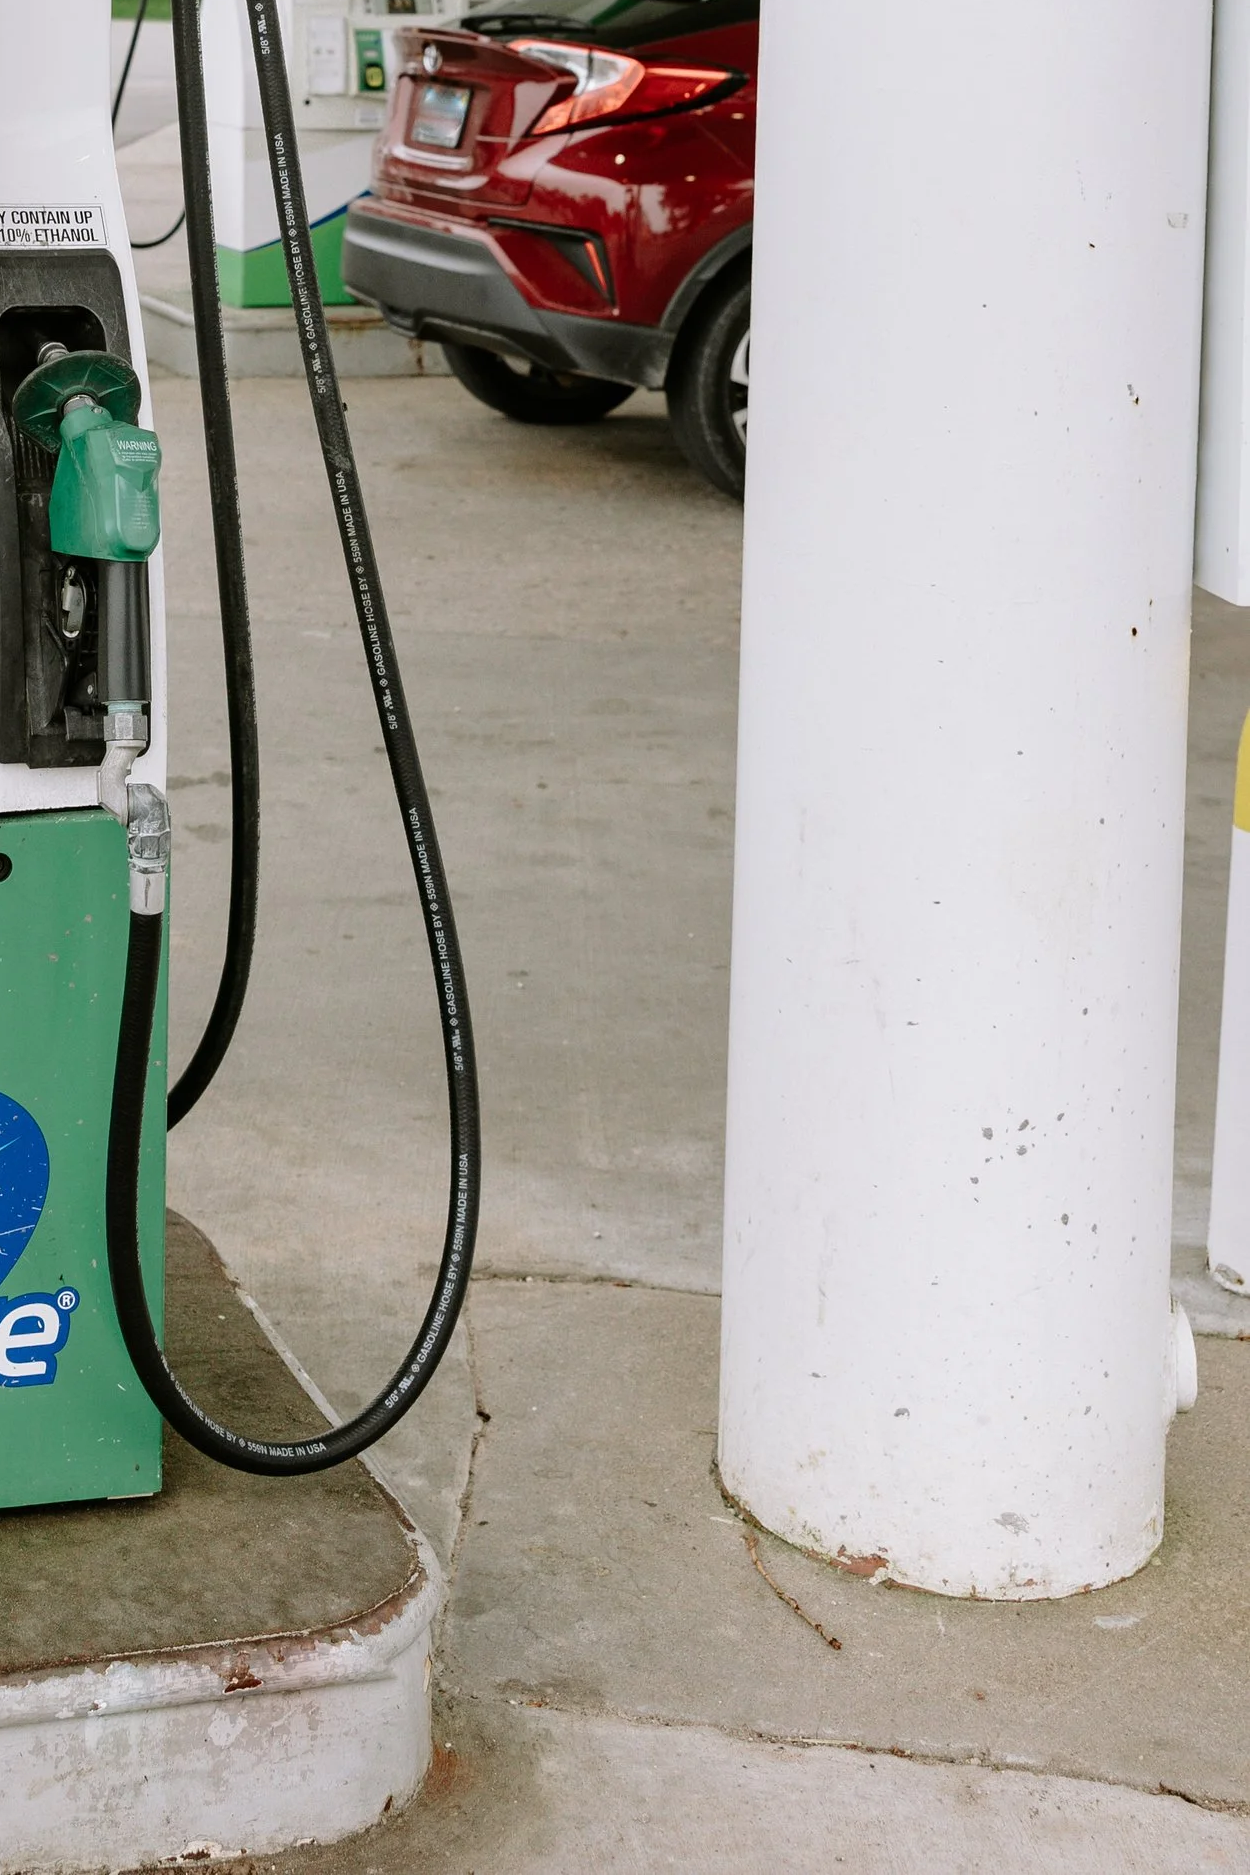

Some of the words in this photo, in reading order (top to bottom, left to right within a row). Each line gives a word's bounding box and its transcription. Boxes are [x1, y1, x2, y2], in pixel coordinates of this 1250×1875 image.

[11, 211, 70, 224] CONTAIN
[75, 211, 92, 223] UP
[0, 229, 30, 242] 10%
[35, 229, 98, 242] ETHANOL
[117, 440, 157, 451] WARNING
[248, 1441, 268, 1454] 559N
[269, 1445, 294, 1457] MADE
[295, 1446, 305, 1456] IN
[307, 1442, 327, 1455] USA
